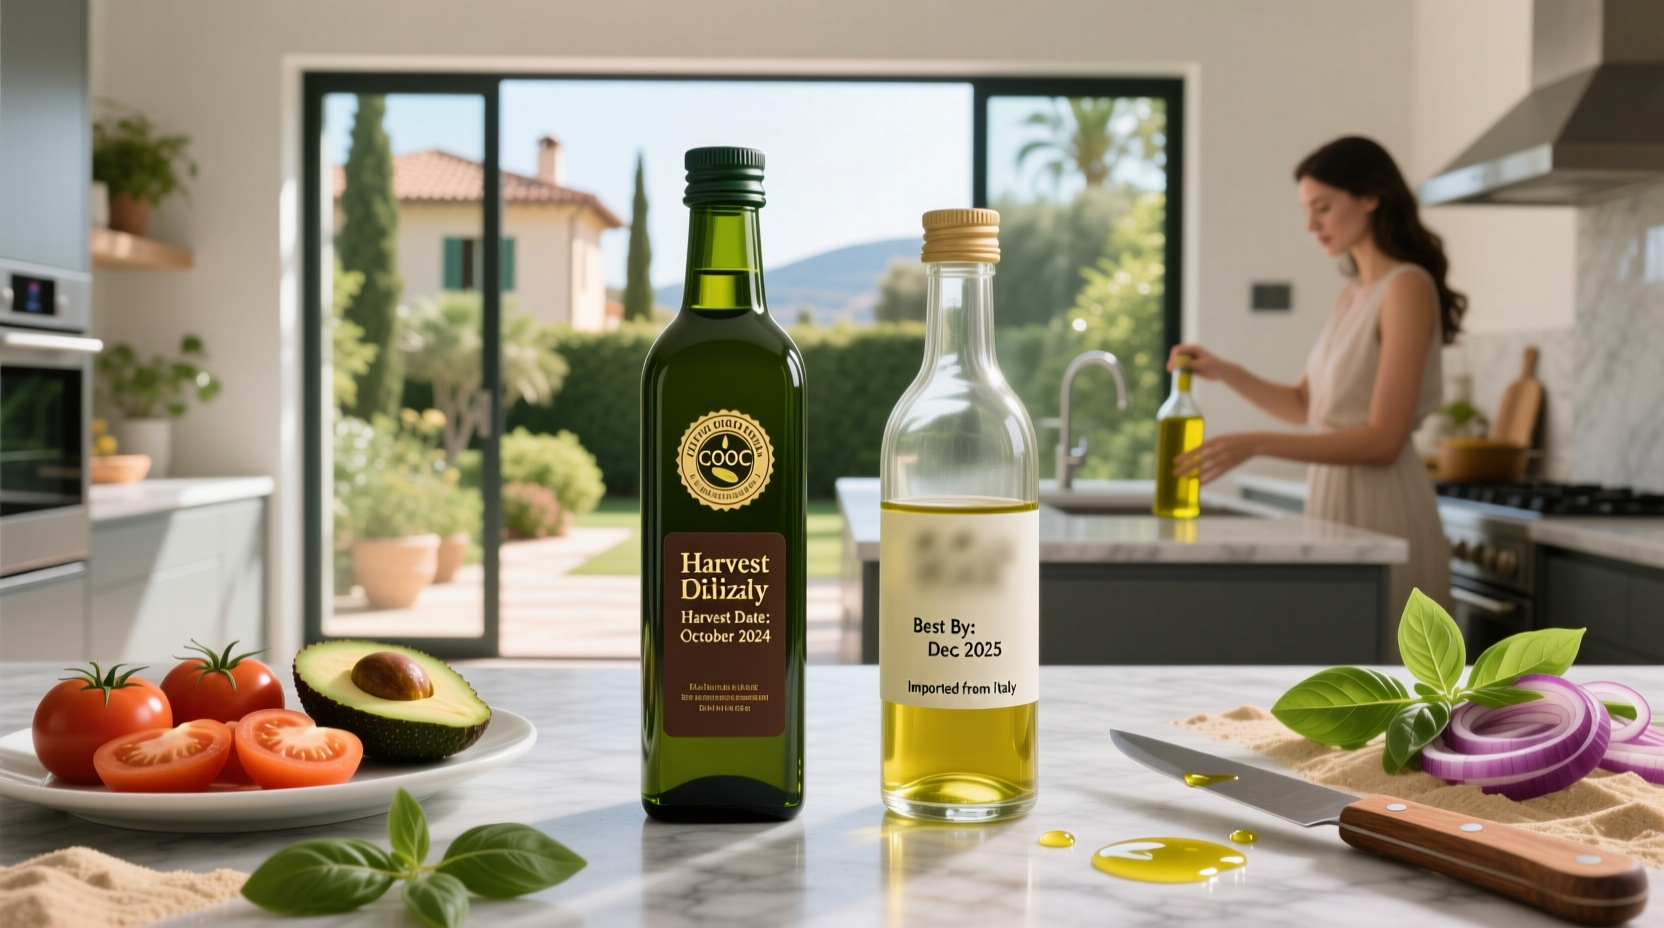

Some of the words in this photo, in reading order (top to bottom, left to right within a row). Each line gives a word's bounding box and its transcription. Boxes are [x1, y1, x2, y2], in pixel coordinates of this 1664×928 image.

[699, 450, 753, 466] COOC
[681, 552, 770, 574] Harvest
[681, 610, 731, 624] Harvest
[735, 611, 770, 624] Date:
[680, 629, 735, 643] October
[739, 629, 771, 643] 2024
[913, 617, 945, 634] Best
[951, 619, 976, 639] By:
[928, 641, 960, 657] Dec
[964, 641, 1002, 657] 2025
[908, 680, 959, 696] Imported
[962, 681, 991, 695] from
[994, 681, 1017, 696] Italy
